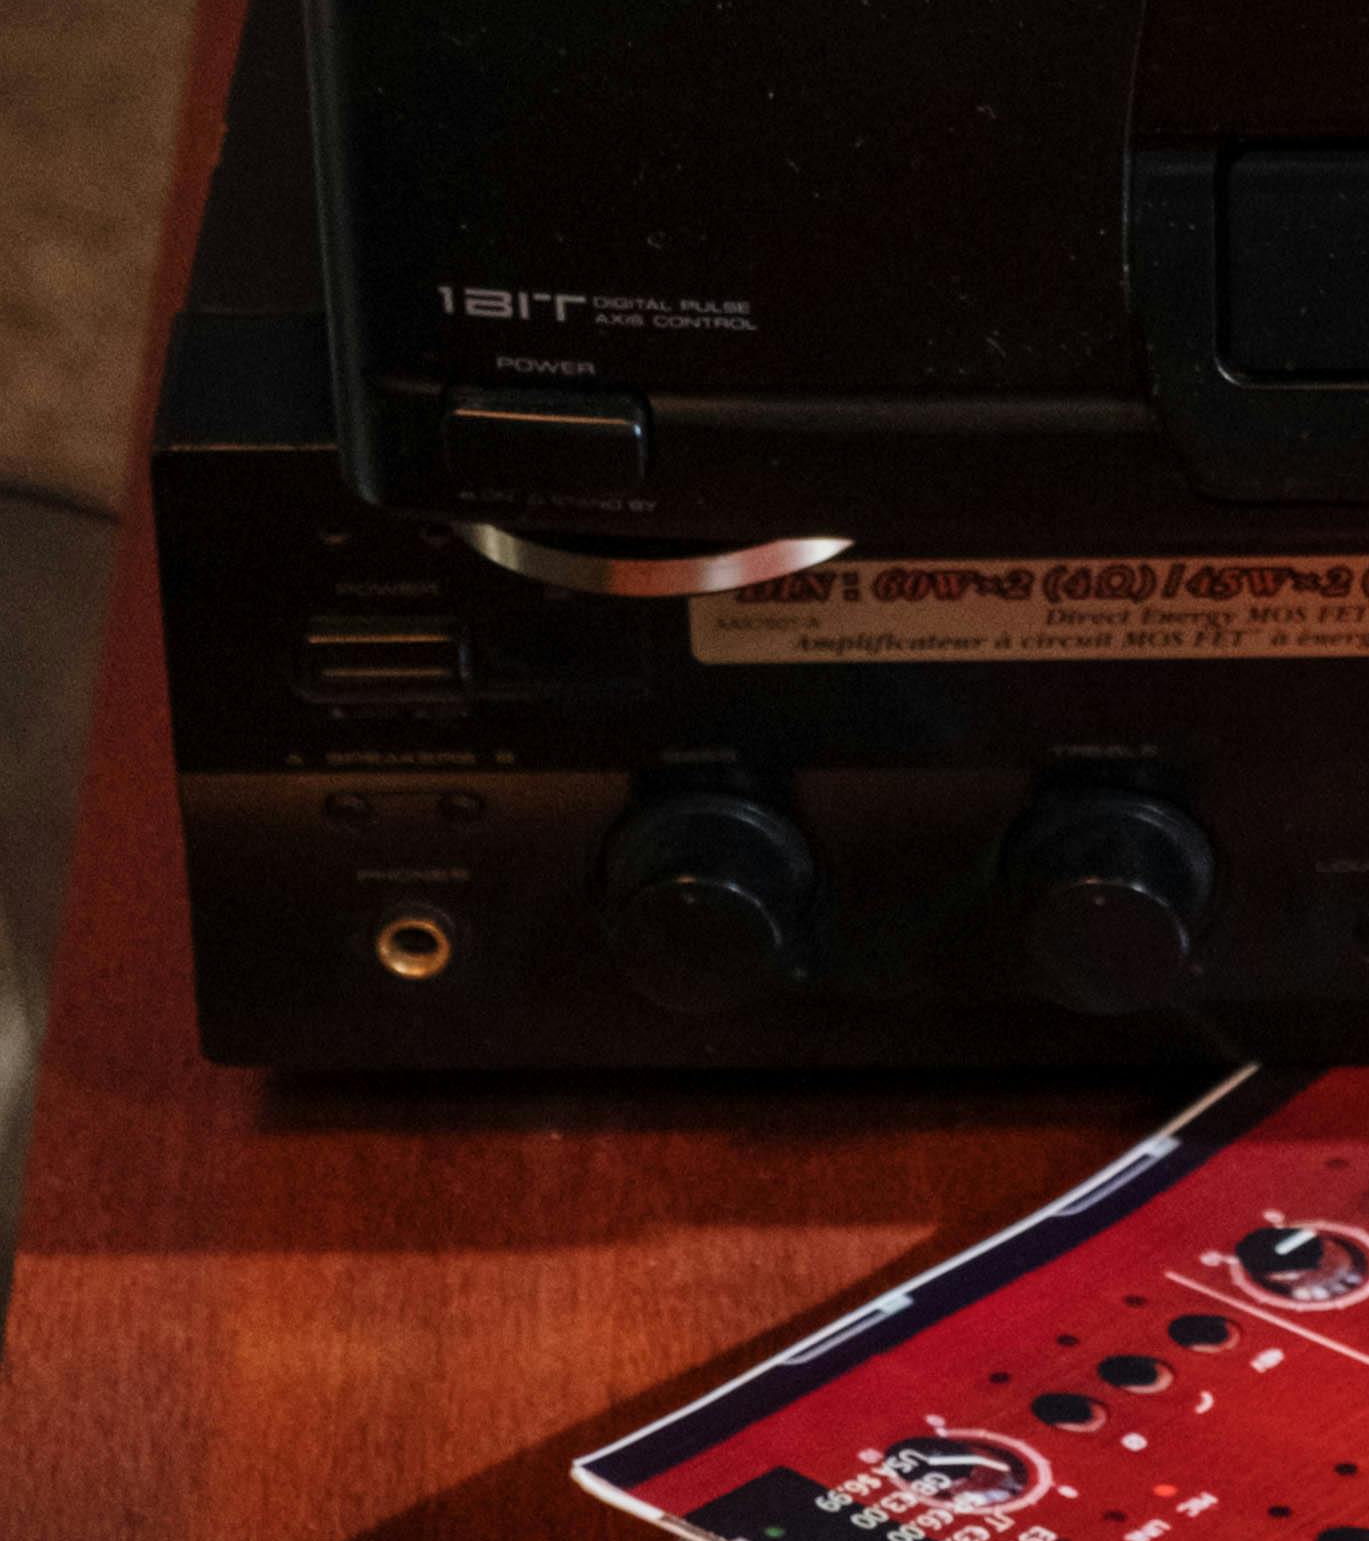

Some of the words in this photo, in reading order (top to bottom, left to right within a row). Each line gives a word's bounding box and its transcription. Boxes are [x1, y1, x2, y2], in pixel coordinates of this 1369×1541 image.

[592, 297, 670, 313] DIGITAL
[678, 299, 751, 315] PULSE
[594, 314, 644, 328] AXIS
[652, 316, 758, 332] CONTROL
[496, 357, 596, 377] POWER
[1046, 608, 1130, 625] Direct
[1141, 607, 1233, 629] Energy
[1248, 606, 1306, 623] MOS
[1317, 605, 1368, 622] FET
[871, 1448, 929, 1479] USA
[815, 1473, 882, 1513] $6.99
[911, 1472, 951, 1497] GB
